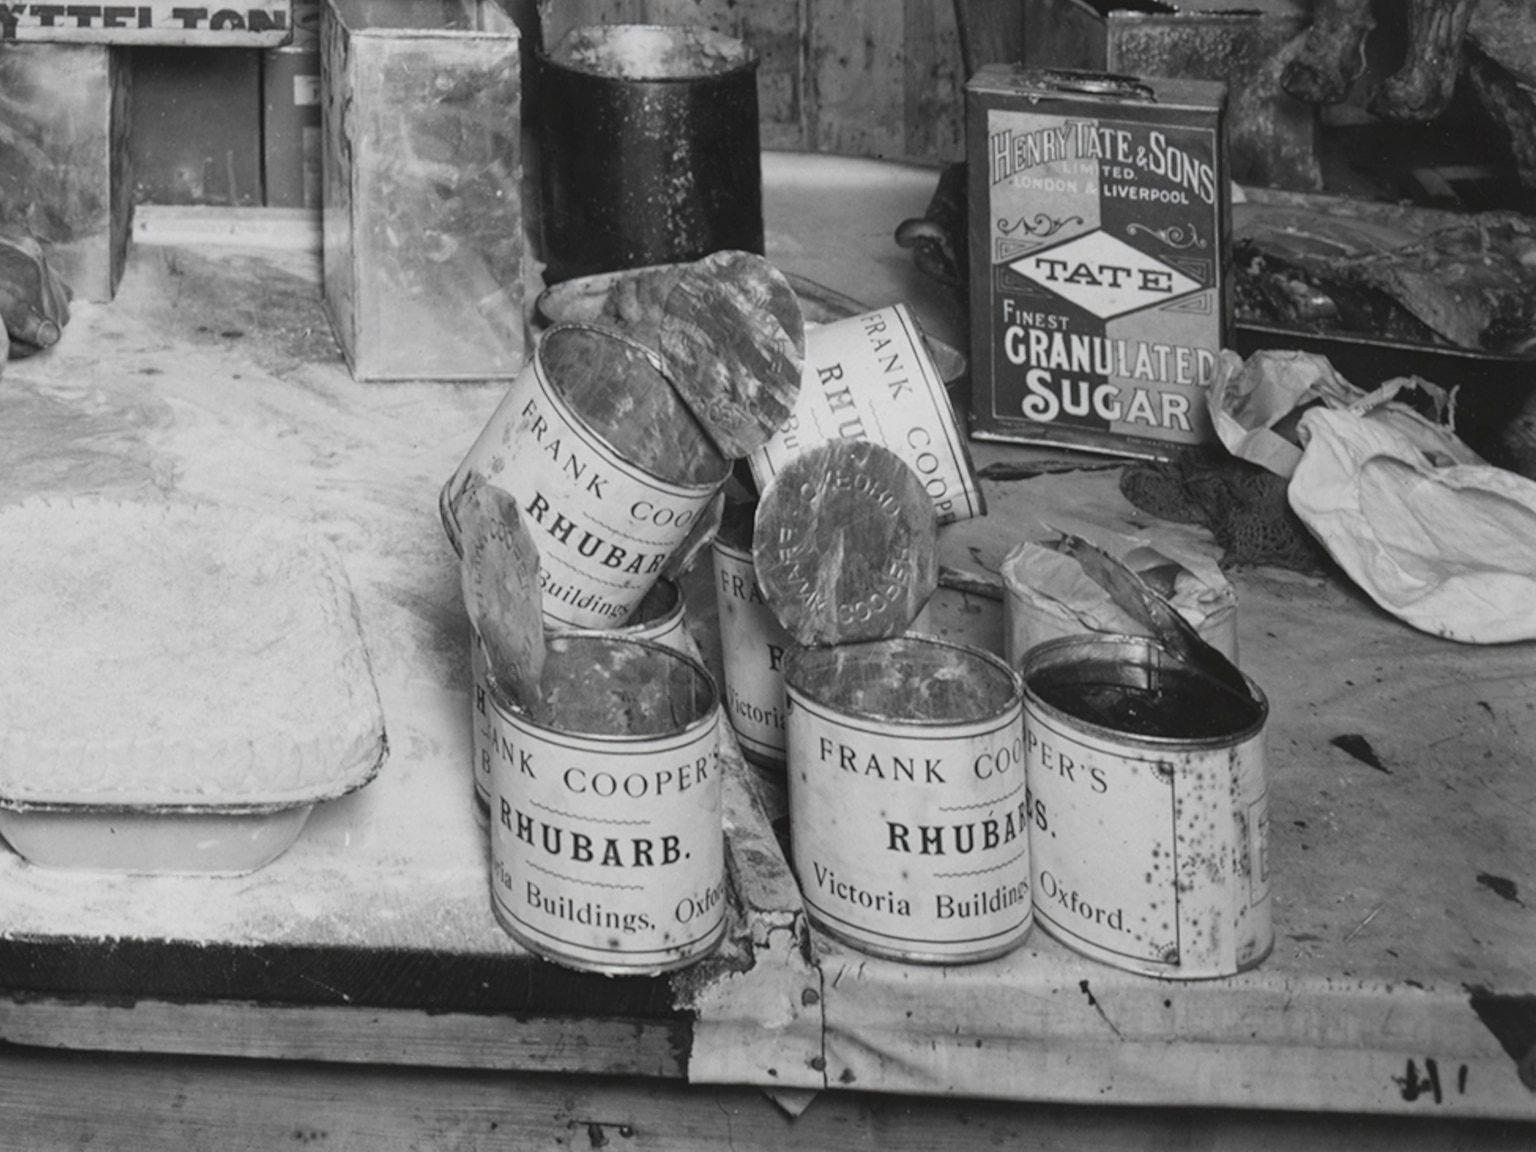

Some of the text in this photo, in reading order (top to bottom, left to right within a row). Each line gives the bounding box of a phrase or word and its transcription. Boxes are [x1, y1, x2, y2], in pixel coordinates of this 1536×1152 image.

[990, 119, 1216, 206] HENRY TATE & SONS
[1014, 175, 1079, 194] LONDON
[1103, 184, 1190, 206] LIVERPOOL
[1034, 257, 1174, 294] TATE
[1002, 298, 1070, 331] FINEST
[860, 313, 914, 401] FRANK
[1004, 325, 1216, 388] GRANULATED
[1020, 367, 1194, 433] SUGAR
[521, 398, 610, 499] FRANK
[818, 736, 947, 784] FRANK
[499, 793, 692, 869] RHUBARB.
[525, 880, 656, 934] Buildings,
[813, 860, 911, 917] Victoria
[1039, 870, 1133, 934] Oxford.
